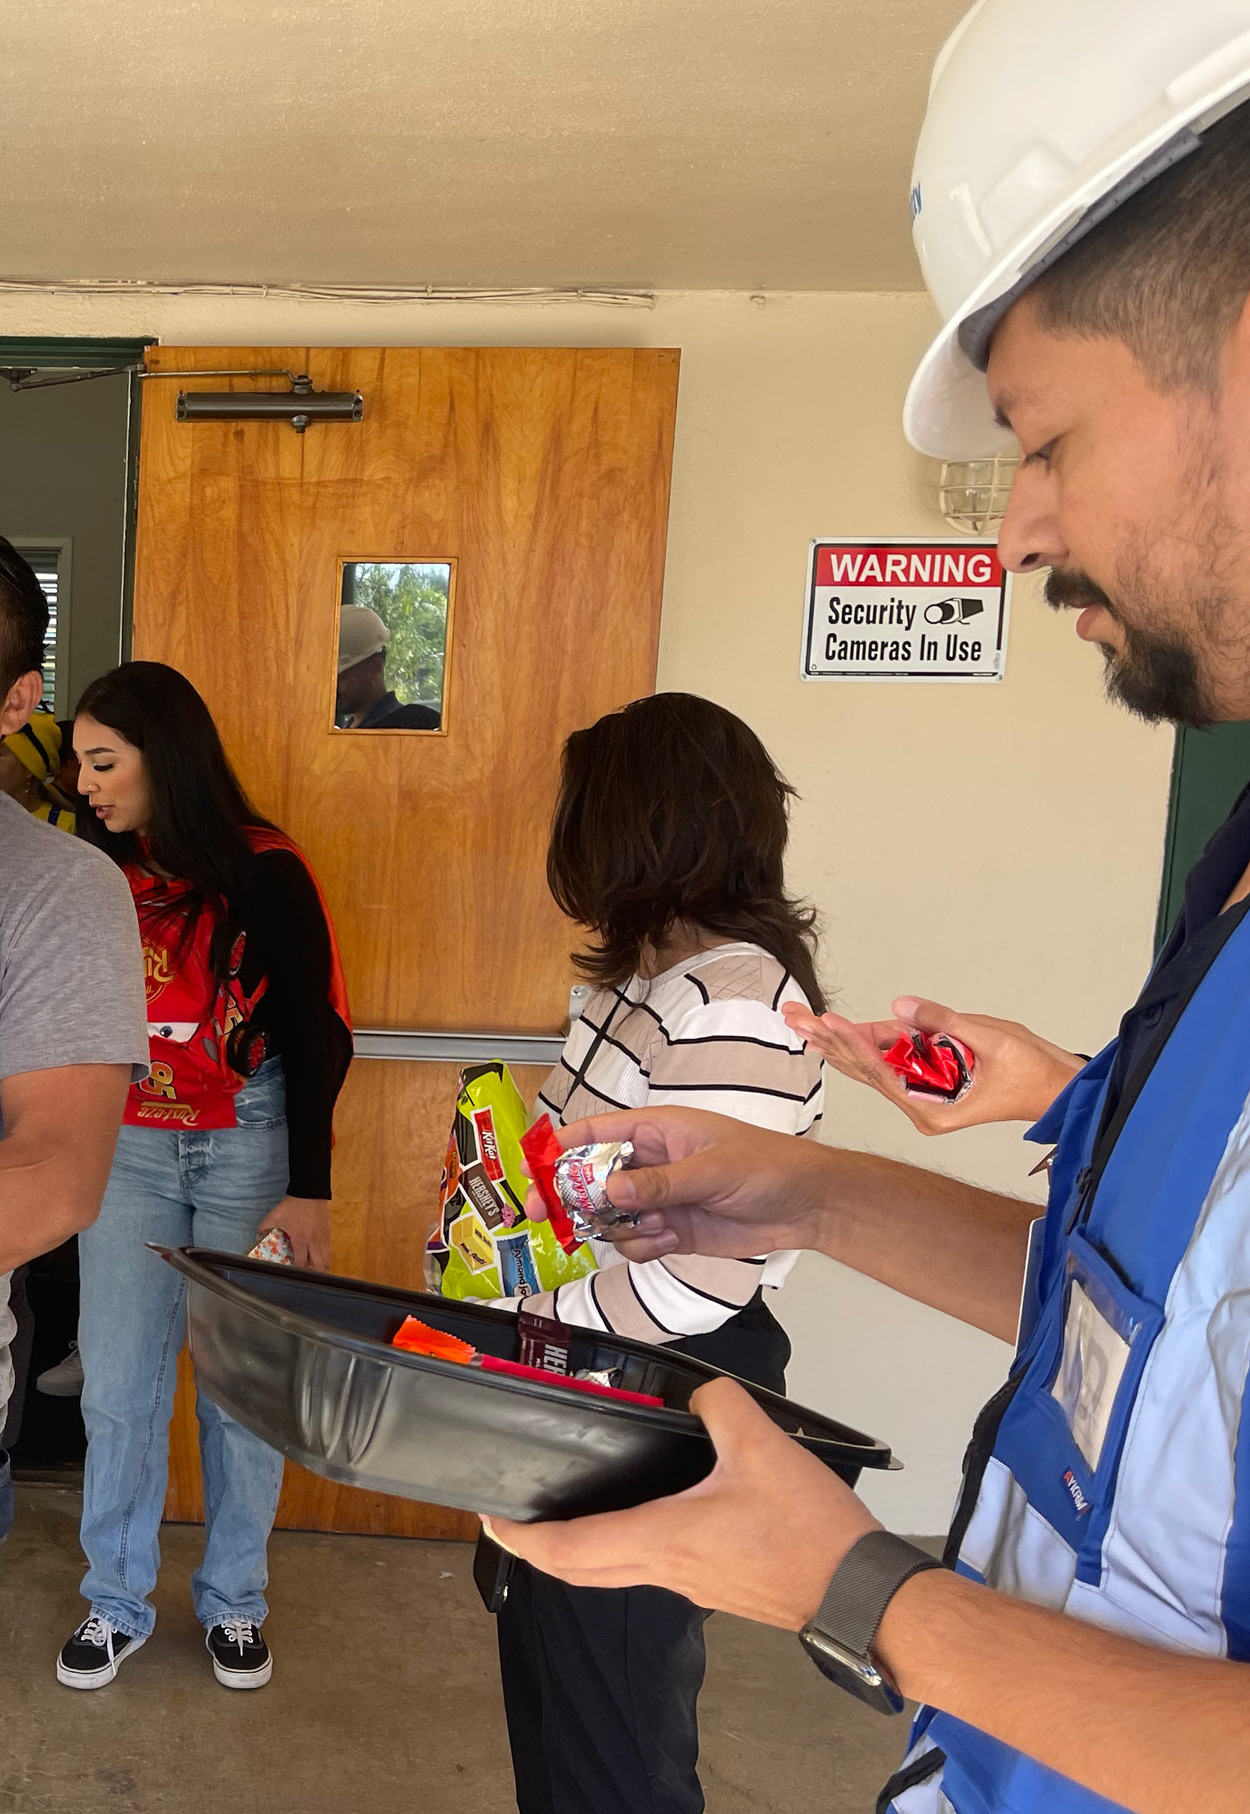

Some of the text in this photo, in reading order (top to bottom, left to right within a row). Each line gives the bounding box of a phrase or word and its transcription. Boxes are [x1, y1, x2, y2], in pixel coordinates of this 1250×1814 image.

[830, 553, 991, 583] WARNING
[828, 596, 916, 631] Security
[825, 632, 982, 661] Cameras In Use
[468, 1176, 500, 1216] HERSHEY'S
[512, 1248, 527, 1285] Almond
